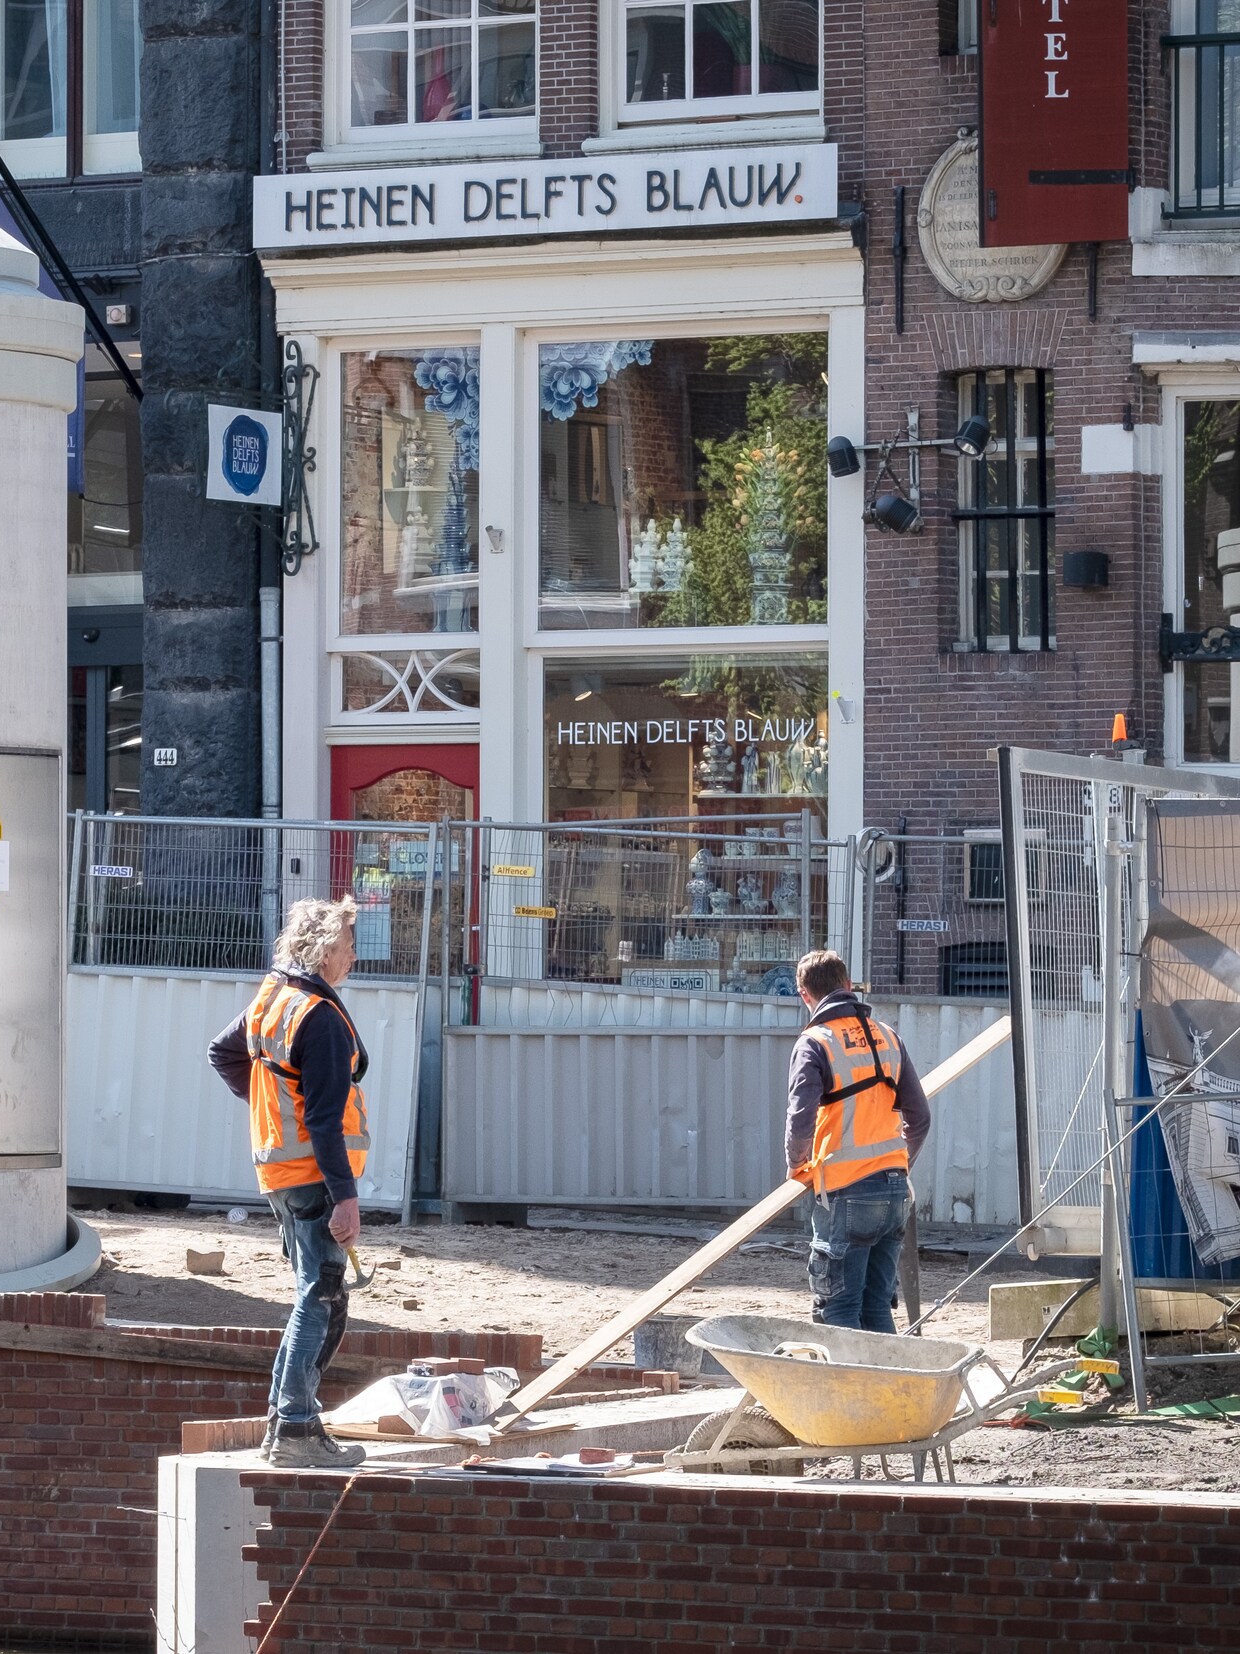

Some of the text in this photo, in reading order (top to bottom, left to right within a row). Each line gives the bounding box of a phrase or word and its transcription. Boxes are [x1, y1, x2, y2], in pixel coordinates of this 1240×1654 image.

[285, 182, 436, 232] HEINEN
[463, 172, 617, 224] DELFTS
[233, 435, 259, 449] HEINEN
[233, 447, 259, 462] DELFTS
[558, 722, 638, 745] HEINEN
[646, 718, 726, 743] DELFTS
[156, 750, 174, 764] 444
[93, 866, 128, 876] HERAS
[901, 921, 941, 931] HERAS
